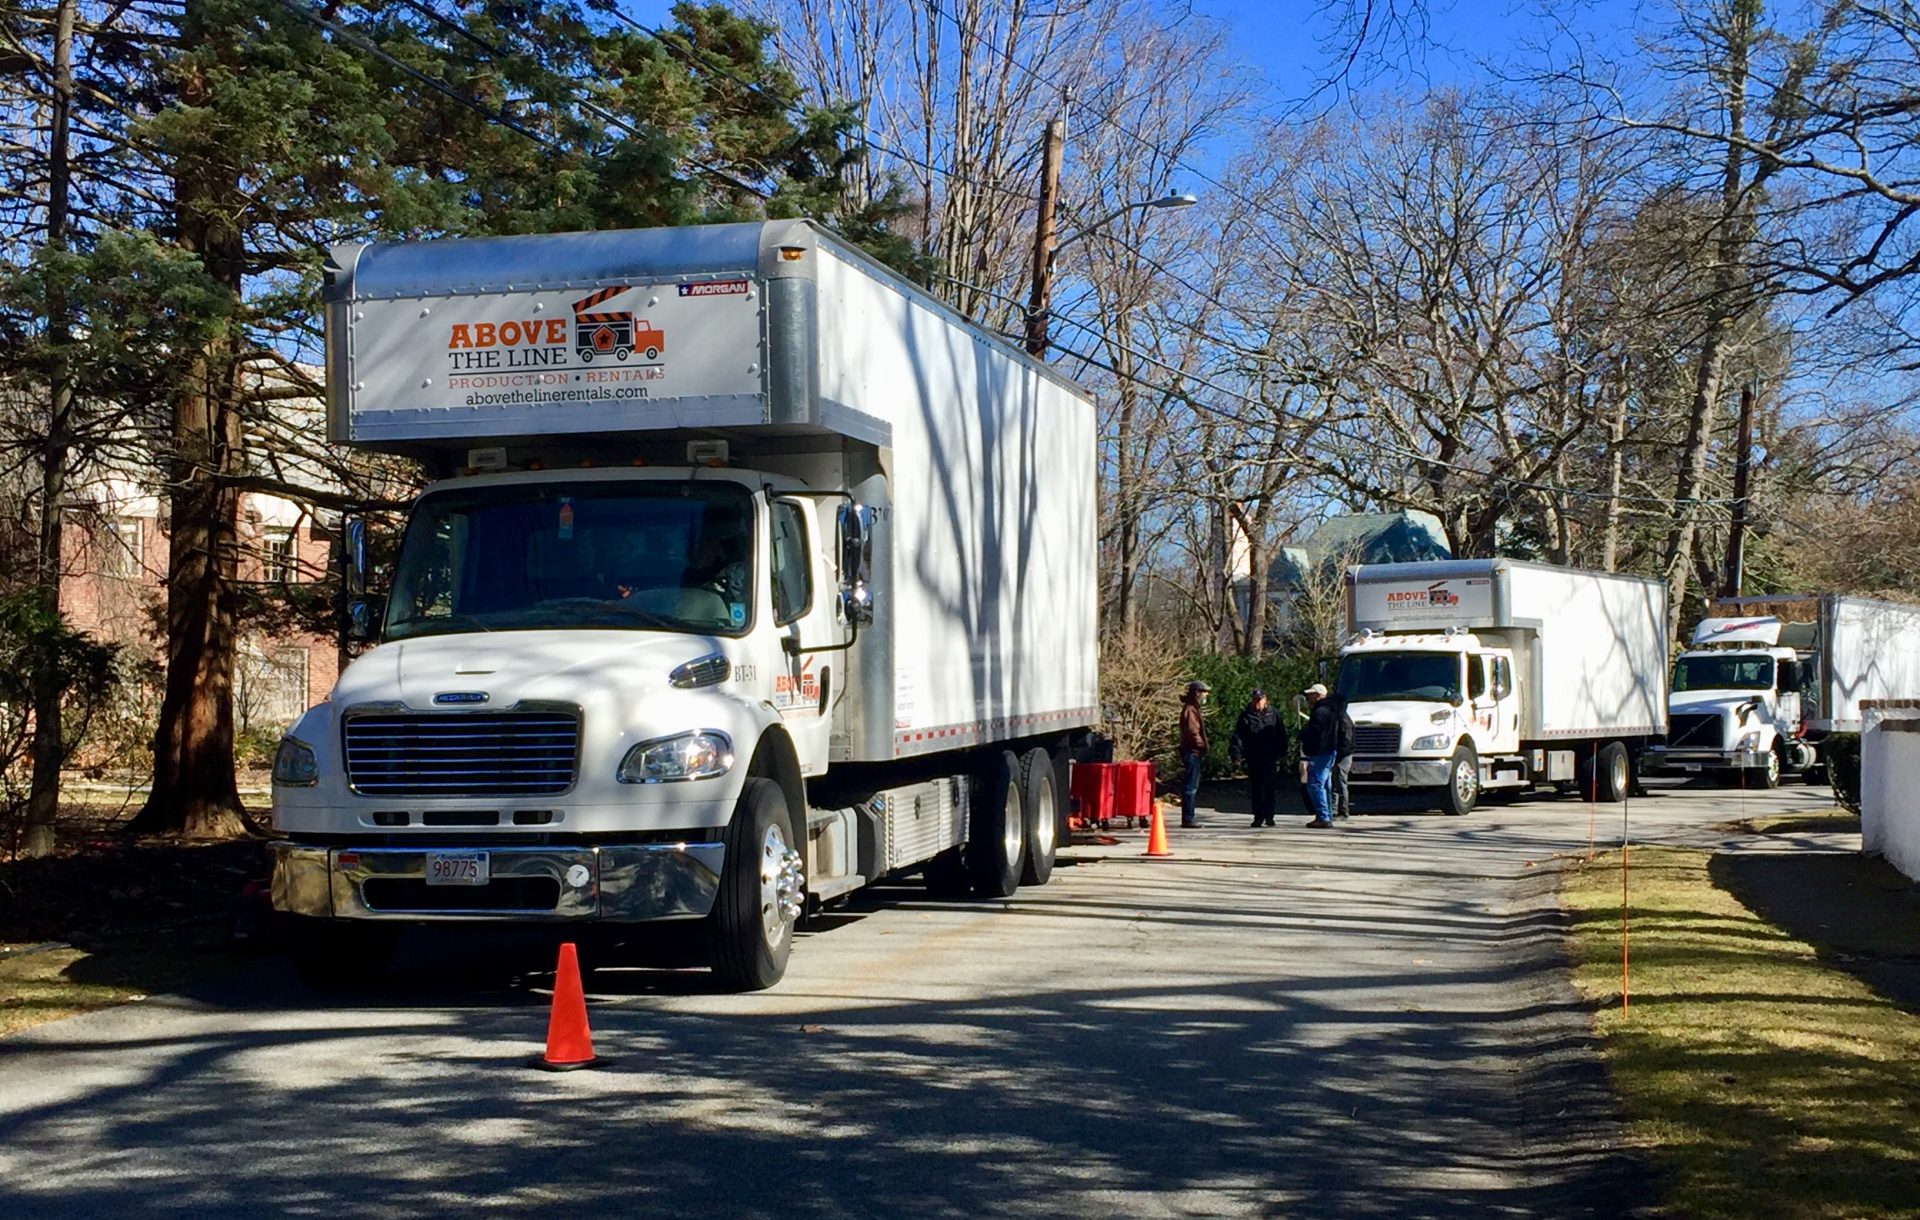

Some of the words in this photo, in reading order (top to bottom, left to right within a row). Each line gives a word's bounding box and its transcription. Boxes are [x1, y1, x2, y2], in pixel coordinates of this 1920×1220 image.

[691, 283, 747, 295] MORGAN
[449, 319, 567, 349] ABOVE
[449, 350, 500, 370] THE
[507, 347, 568, 367] LINE
[449, 373, 569, 389] PRODUCTON
[466, 386, 648, 406] abovethelinerentals.com
[1387, 591, 1427, 601] ABOVE
[433, 860, 478, 878] 98775
